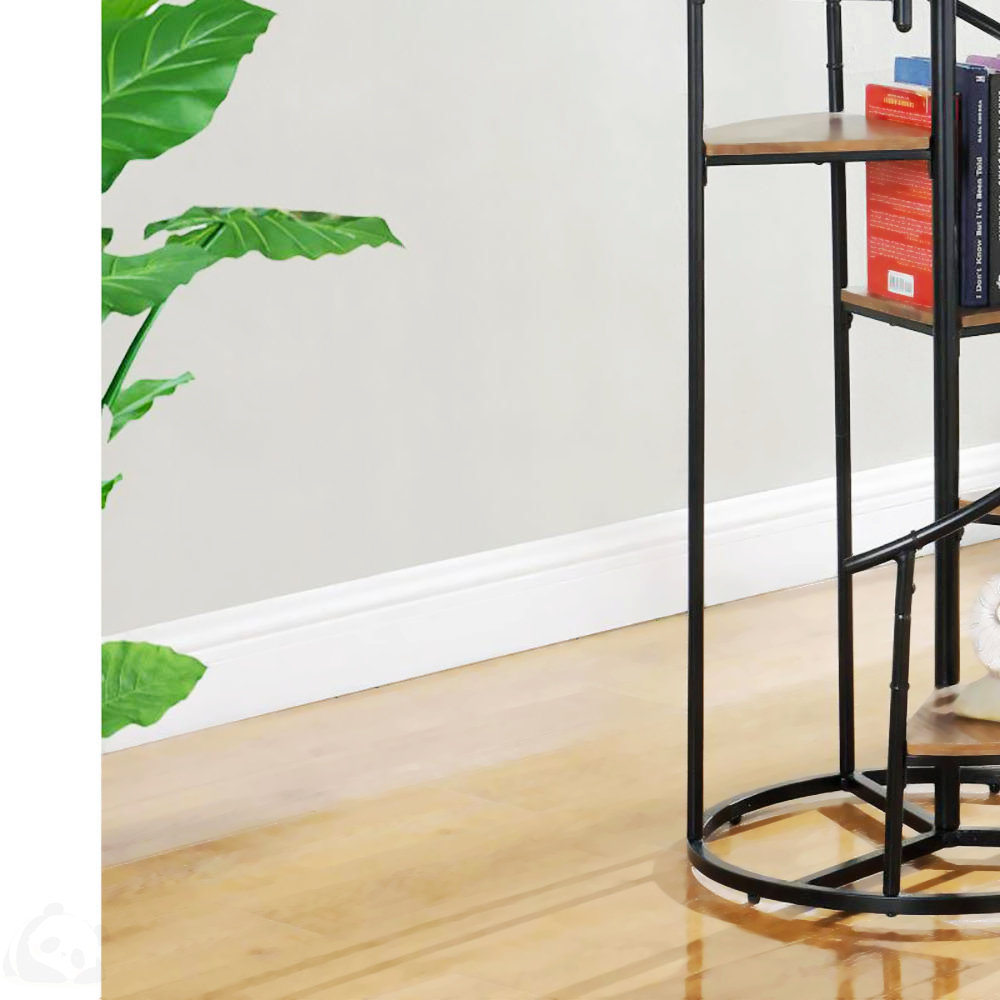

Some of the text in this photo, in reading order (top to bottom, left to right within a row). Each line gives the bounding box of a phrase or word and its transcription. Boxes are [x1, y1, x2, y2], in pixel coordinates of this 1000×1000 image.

[975, 156, 983, 177] Told
[975, 178, 983, 200] Been
[975, 201, 983, 219] I've
[975, 221, 983, 237] But
[975, 240, 983, 265] Know
[975, 268, 983, 292] Don't
